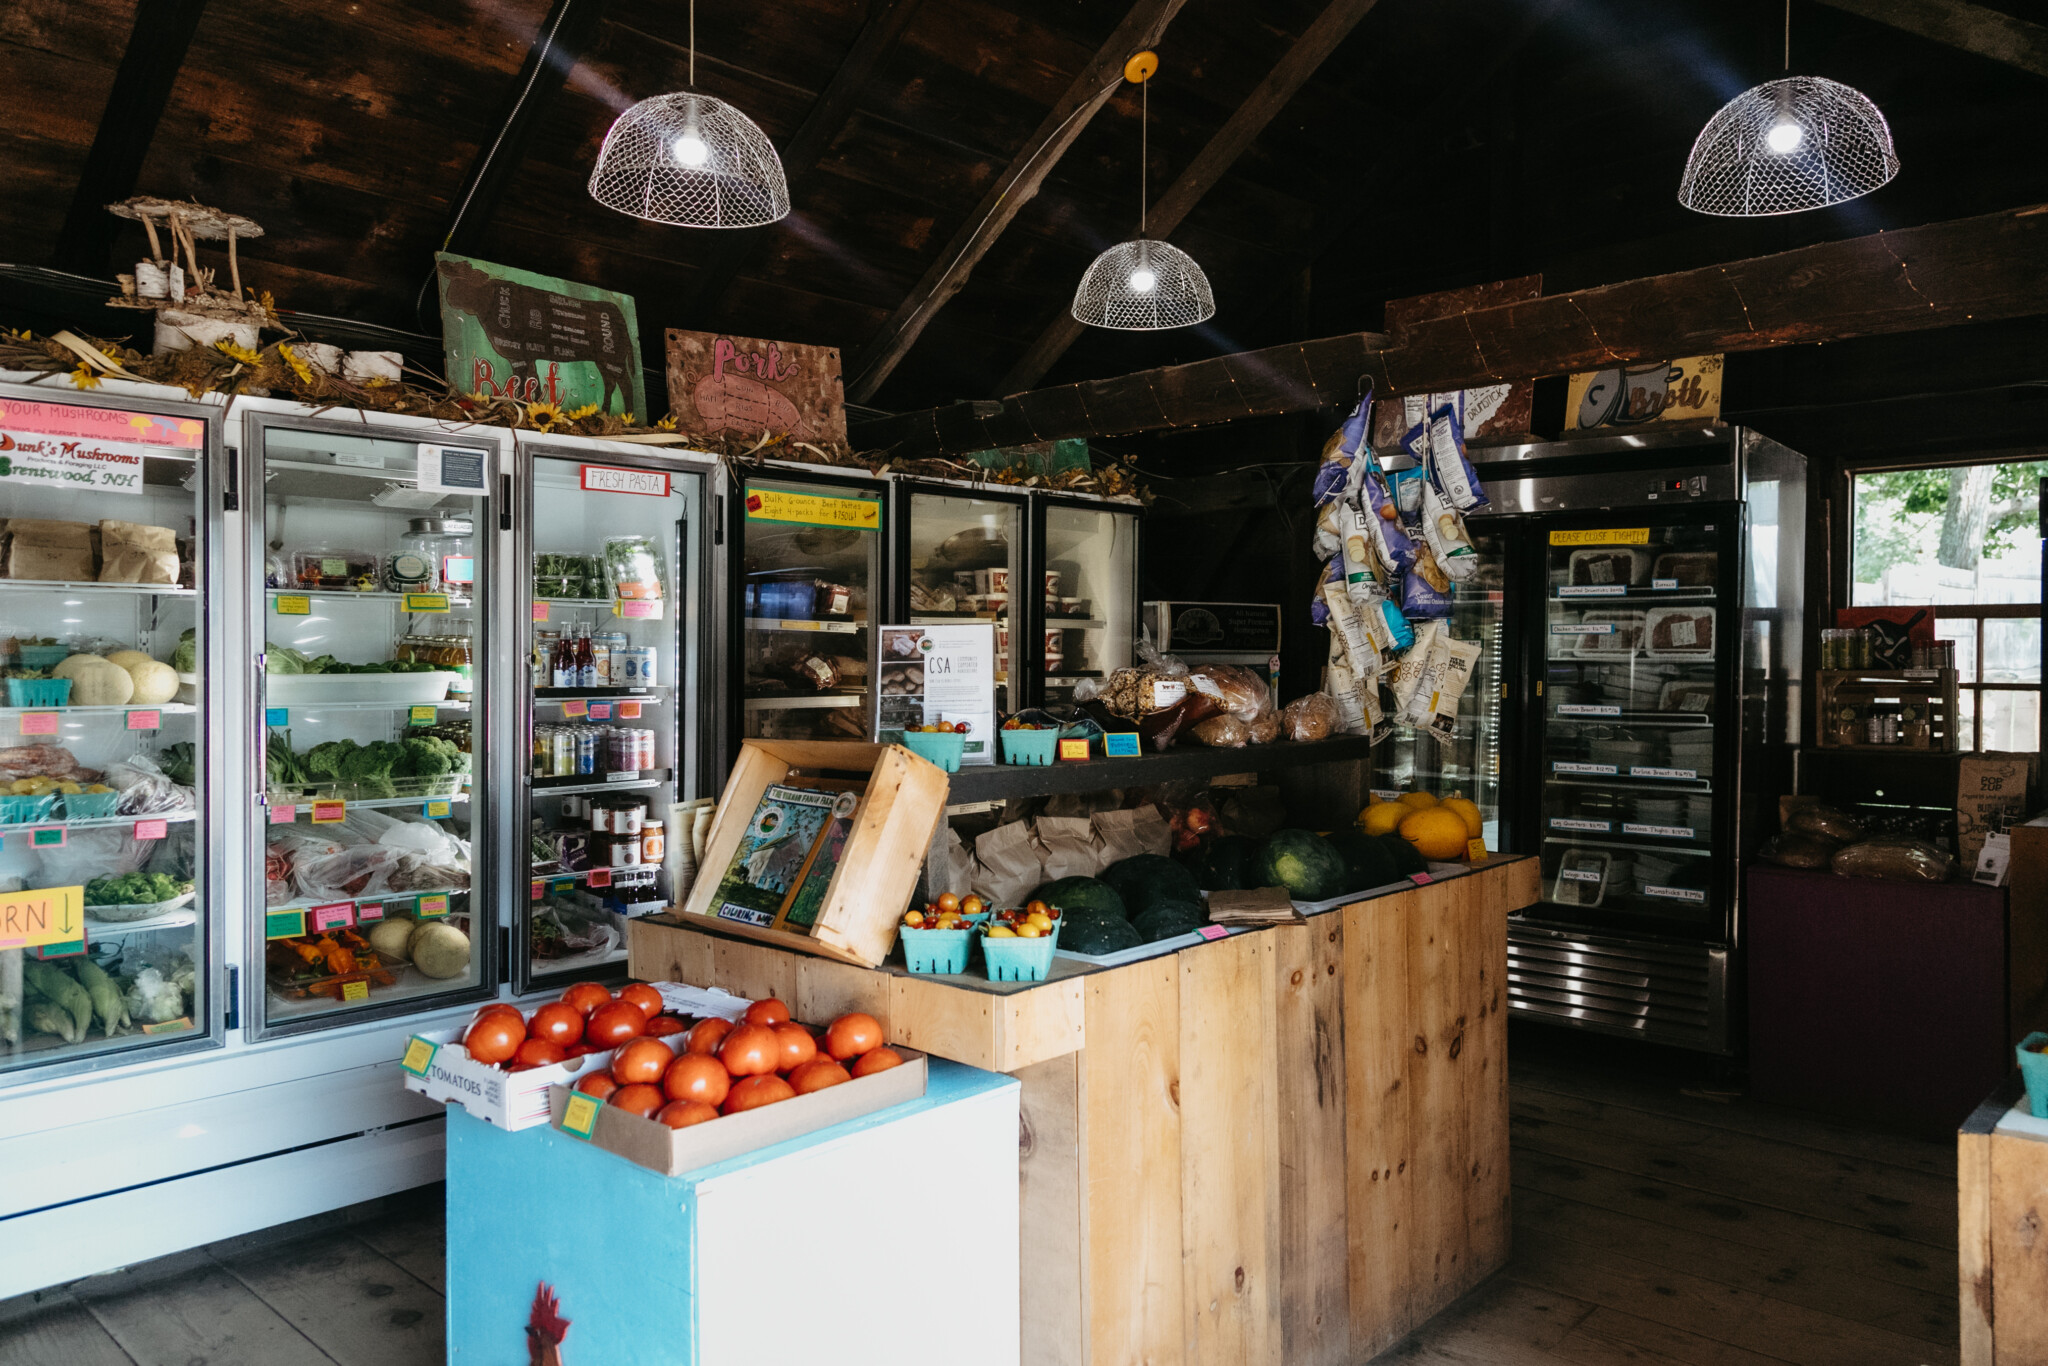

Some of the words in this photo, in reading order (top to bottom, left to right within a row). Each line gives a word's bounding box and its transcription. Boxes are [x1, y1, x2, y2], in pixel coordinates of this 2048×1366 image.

[498, 287, 511, 329] CHUCK
[601, 312, 616, 354] ROUND
[713, 338, 801, 383] Pork
[472, 357, 567, 408] Beef
[700, 394, 718, 403] HAM
[1468, 387, 1504, 421] DRUMSTICK
[1629, 375, 1710, 419] Broth
[4, 402, 42, 417] YOUR
[50, 407, 129, 425] MUSHROOMS
[60, 442, 140, 465] Mushrooms
[64, 460, 93, 470] Foraging
[93, 463, 107, 471] LLC
[101, 473, 138, 488] NH
[591, 470, 625, 489] FRESH
[629, 474, 661, 491] PASTA
[764, 493, 783, 504] Bulk
[788, 496, 816, 506] 6-ounce
[822, 499, 837, 508] Beef
[764, 505, 782, 518] Eight
[787, 508, 813, 517] 4-packs
[820, 508, 830, 516] for
[1553, 532, 1581, 542] PLEASE
[1584, 531, 1608, 541] CLOSE
[1613, 529, 1648, 541] TIGHTLY
[929, 656, 951, 674] CSA
[1980, 784, 2002, 792] ZUP
[1981, 776, 2003, 785] POP
[772, 788, 784, 798] THE
[0, 901, 46, 933] RN
[722, 905, 755, 922] COLORING
[430, 1064, 482, 1097] TOMATOES
